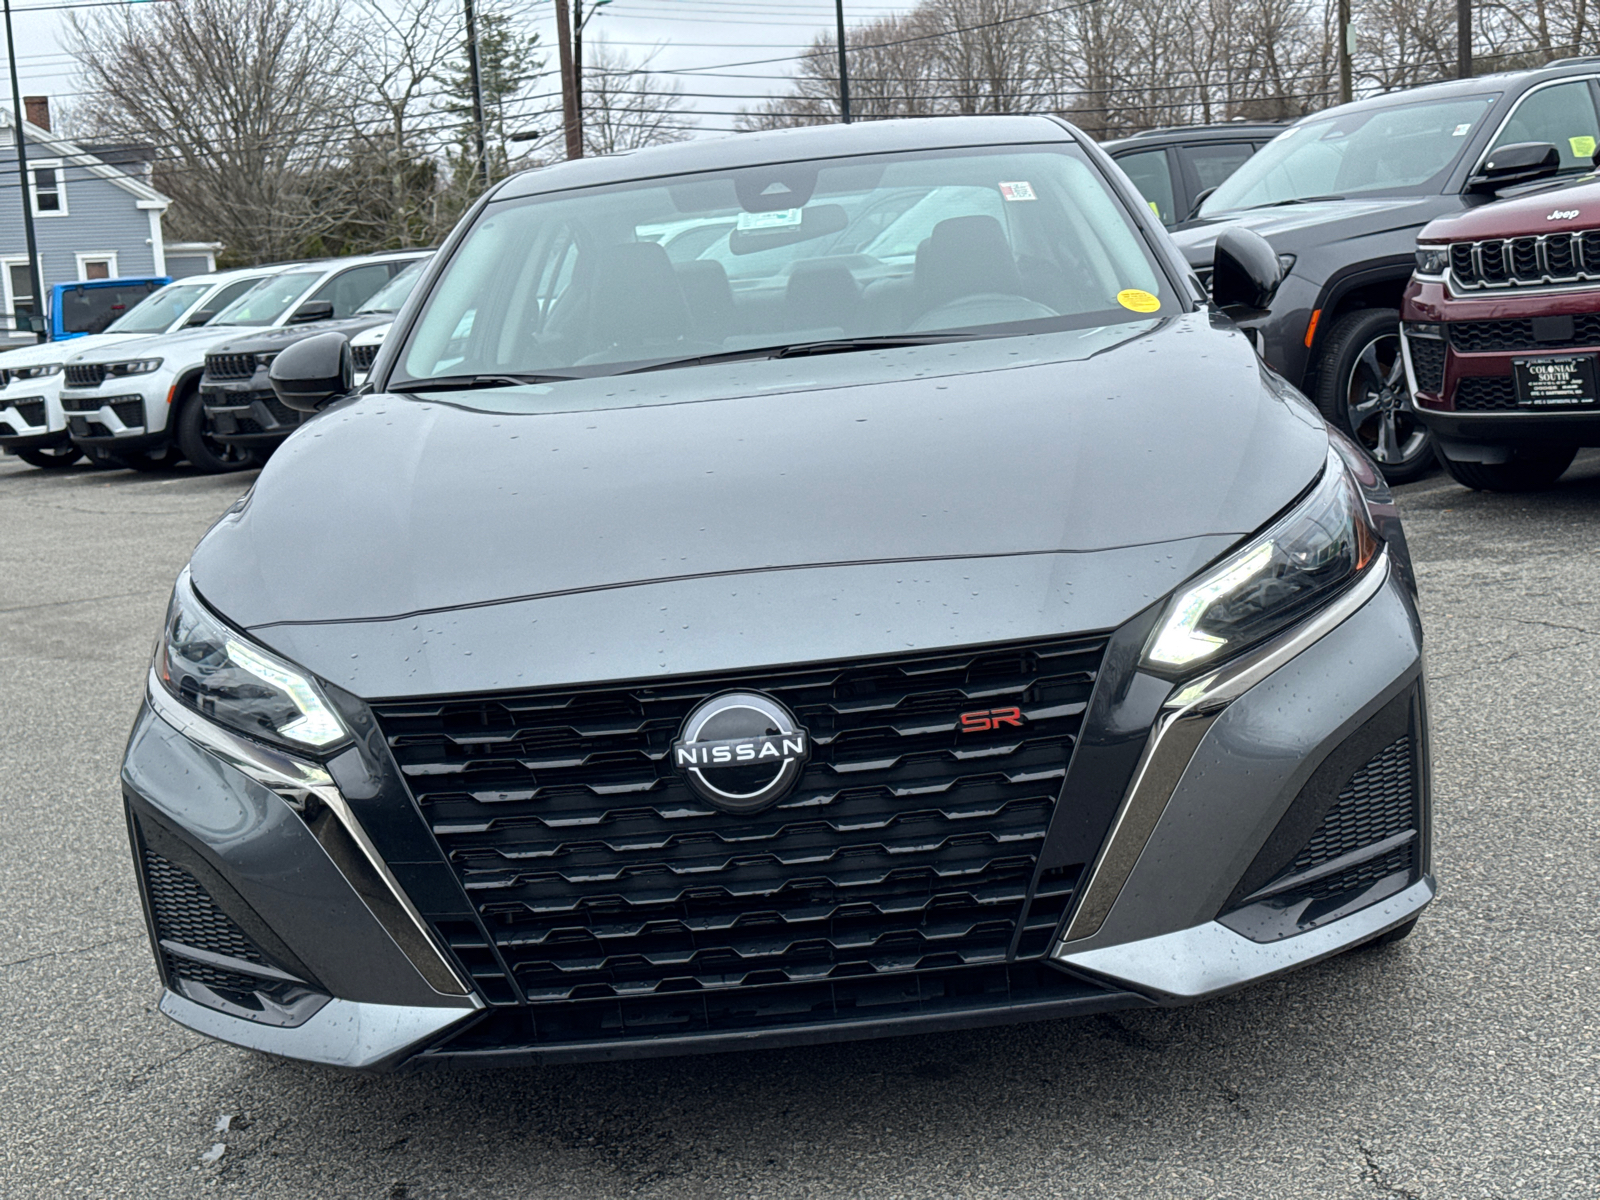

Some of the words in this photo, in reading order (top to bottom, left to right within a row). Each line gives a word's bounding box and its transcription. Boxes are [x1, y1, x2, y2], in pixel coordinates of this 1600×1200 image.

[1547, 210, 1580, 220] Jeep
[1529, 364, 1577, 374] COLONIAL
[1538, 372, 1570, 381] SOUTH
[960, 706, 1024, 733] SR
[677, 737, 803, 764] NISSAN
